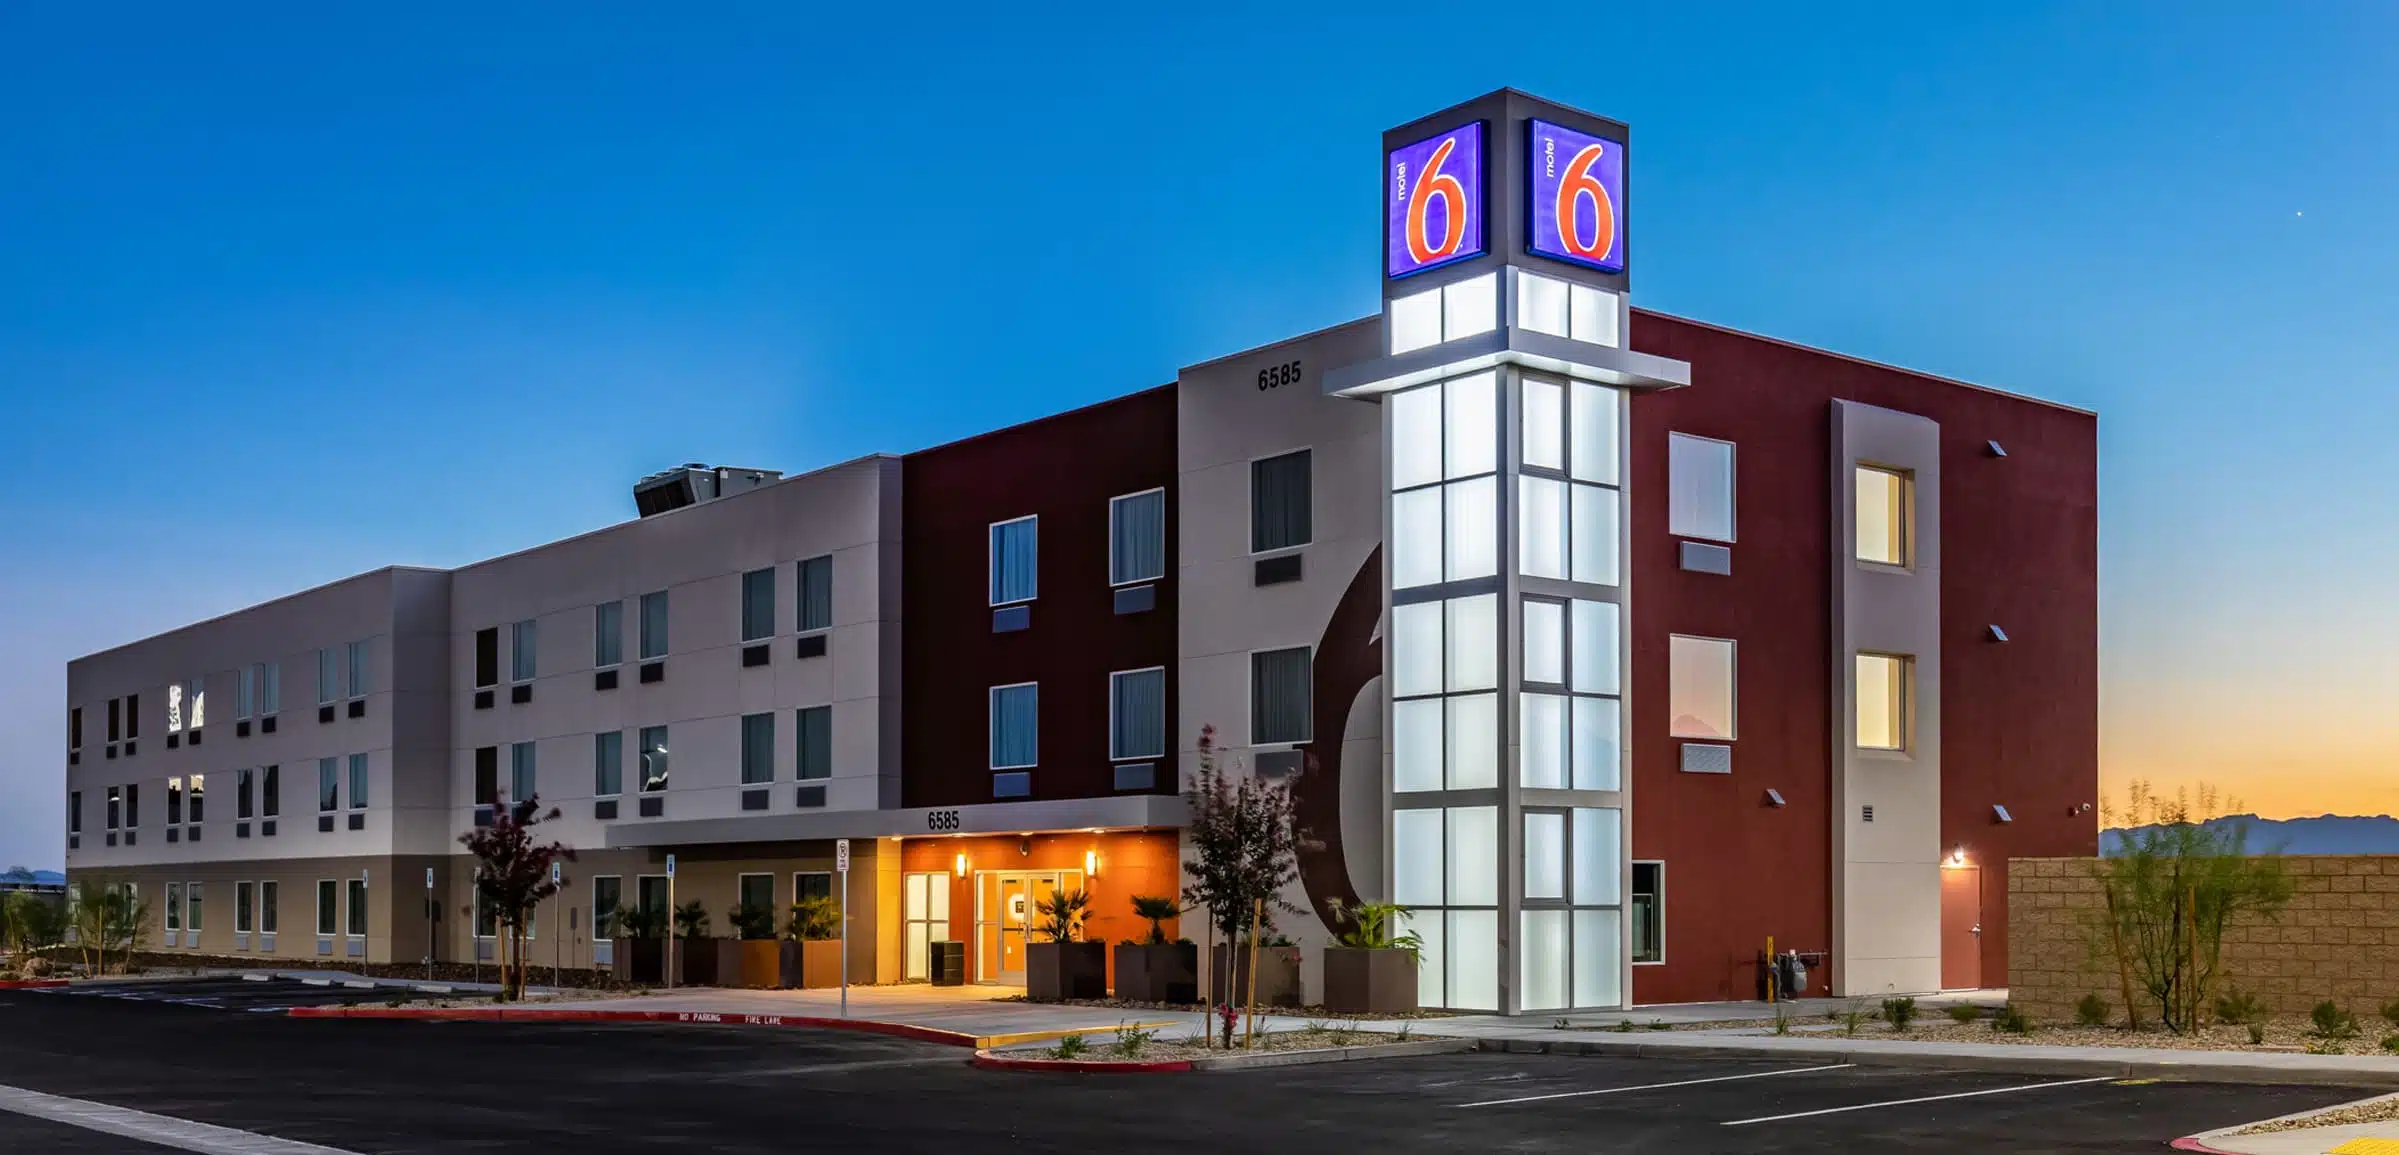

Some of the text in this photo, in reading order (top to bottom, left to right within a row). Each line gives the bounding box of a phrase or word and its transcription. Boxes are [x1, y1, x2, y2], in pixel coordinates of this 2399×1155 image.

[1544, 137, 1554, 178] motel
[1396, 162, 1406, 201] motel
[1406, 137, 1467, 264] 6
[1556, 143, 1615, 261] 6
[1258, 360, 1301, 391] 6585
[928, 810, 960, 830] 6585
[679, 1013, 689, 1021] NO
[693, 1013, 721, 1022] PARKING
[764, 1016, 782, 1025] LANE
